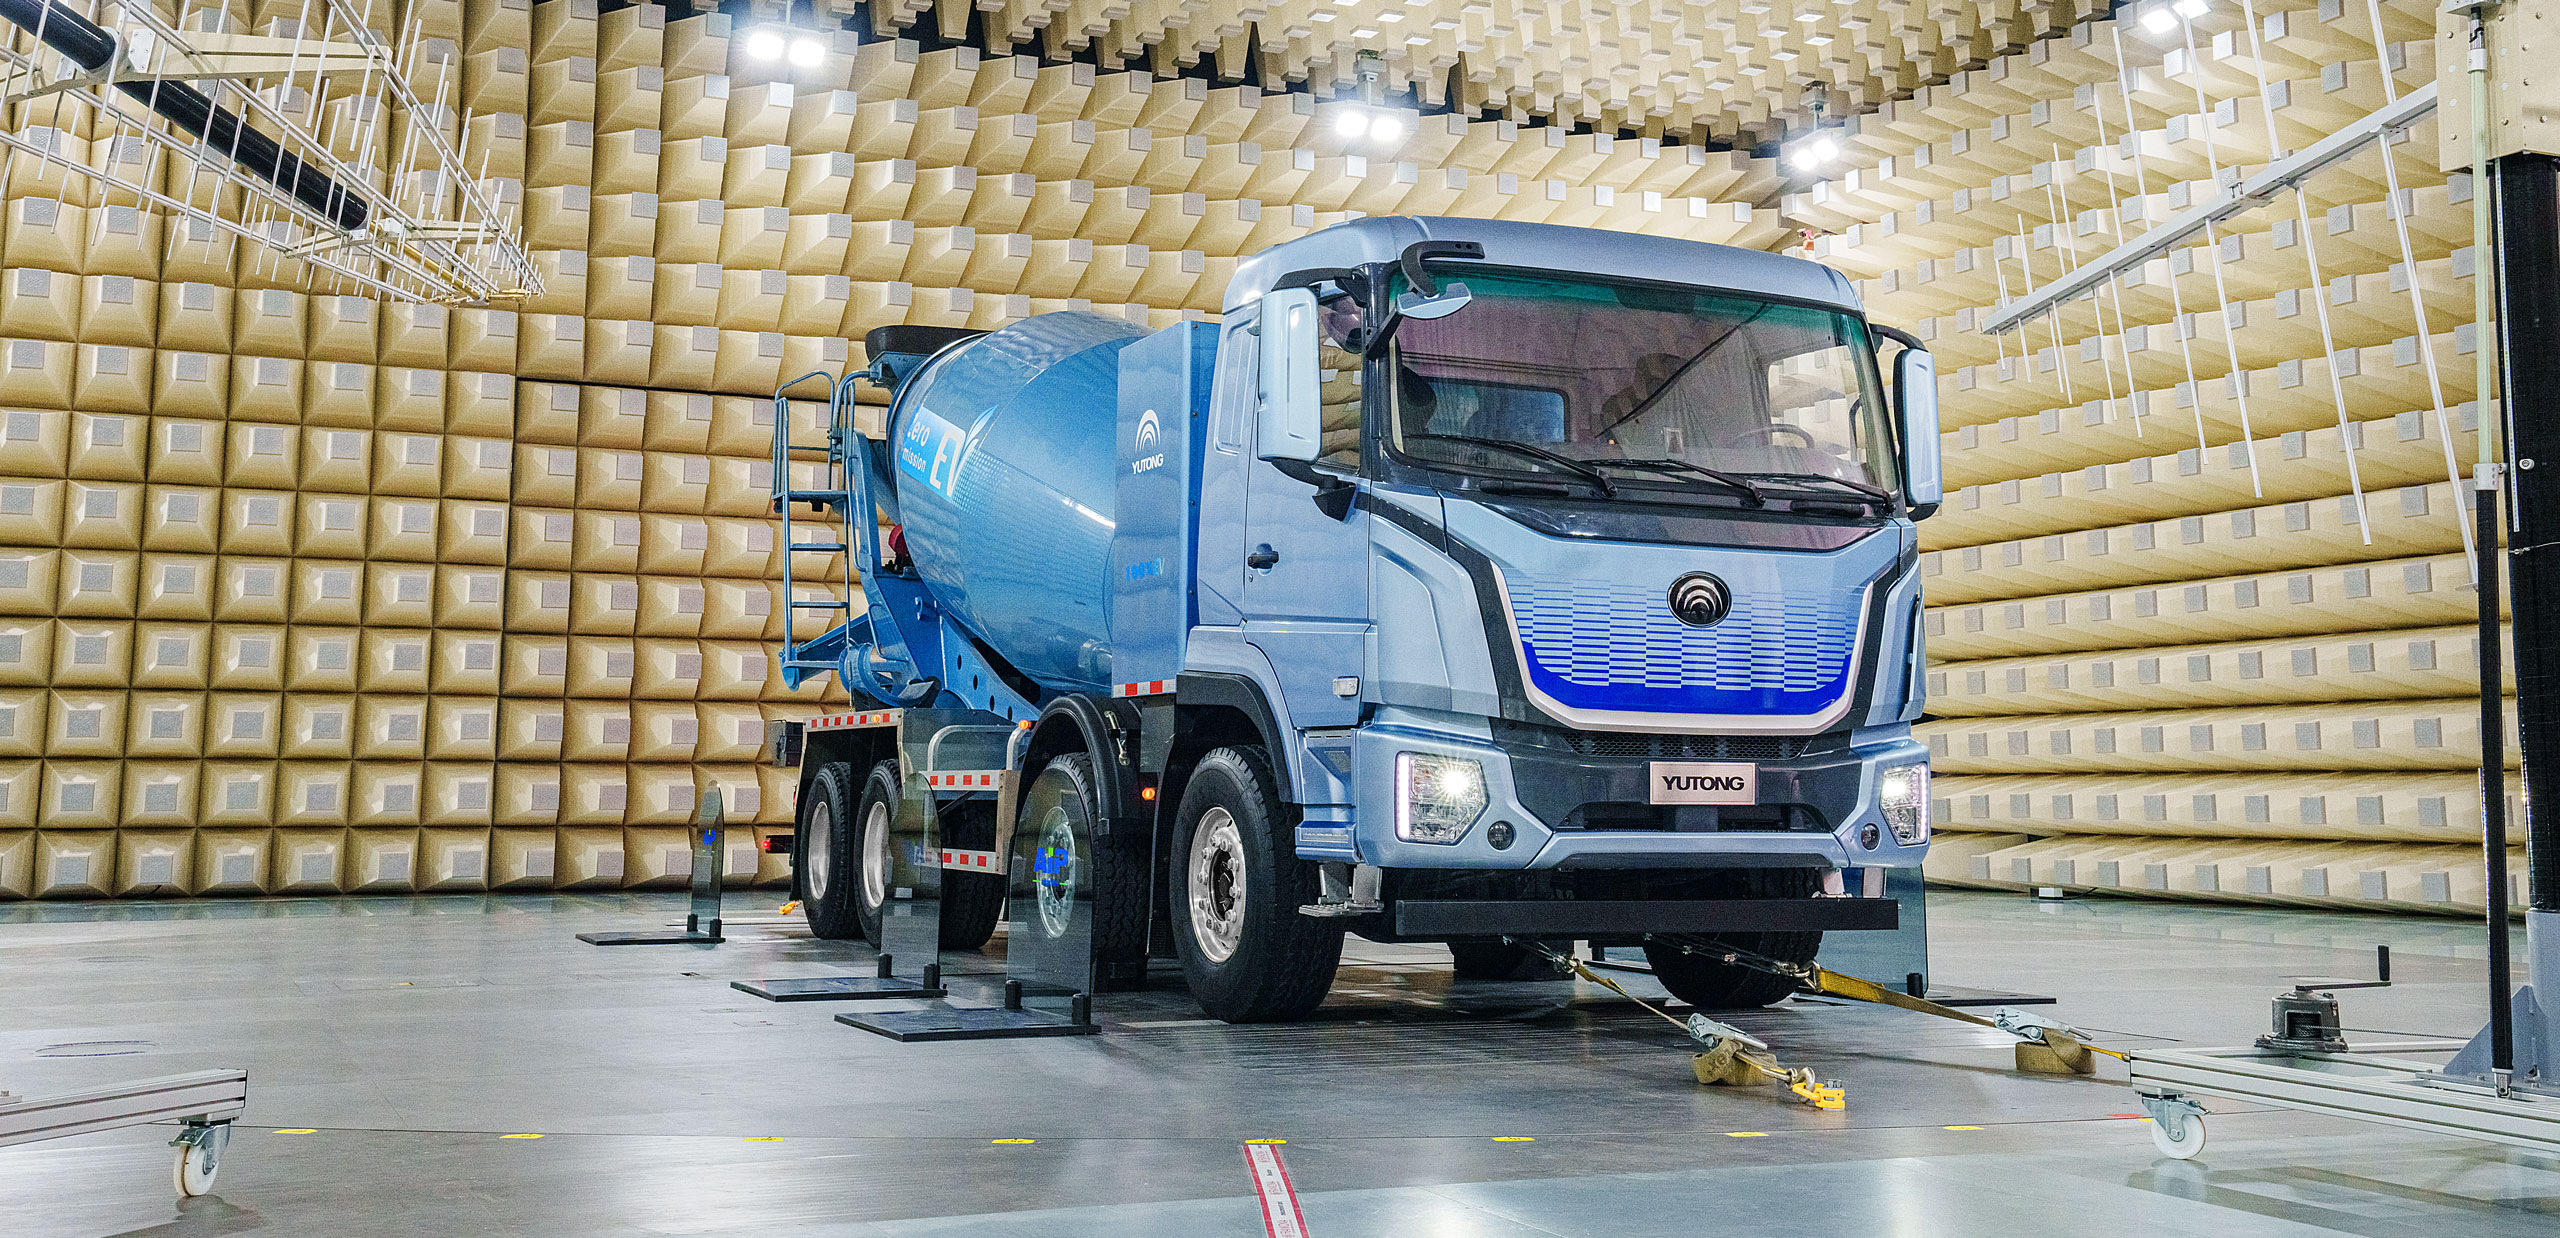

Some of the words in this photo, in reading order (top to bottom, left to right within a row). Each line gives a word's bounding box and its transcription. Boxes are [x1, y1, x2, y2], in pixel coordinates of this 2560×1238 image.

[929, 428, 979, 497] EV
[1131, 453, 1164, 475] YUTONG
[1661, 775, 1745, 791] YUTONG
